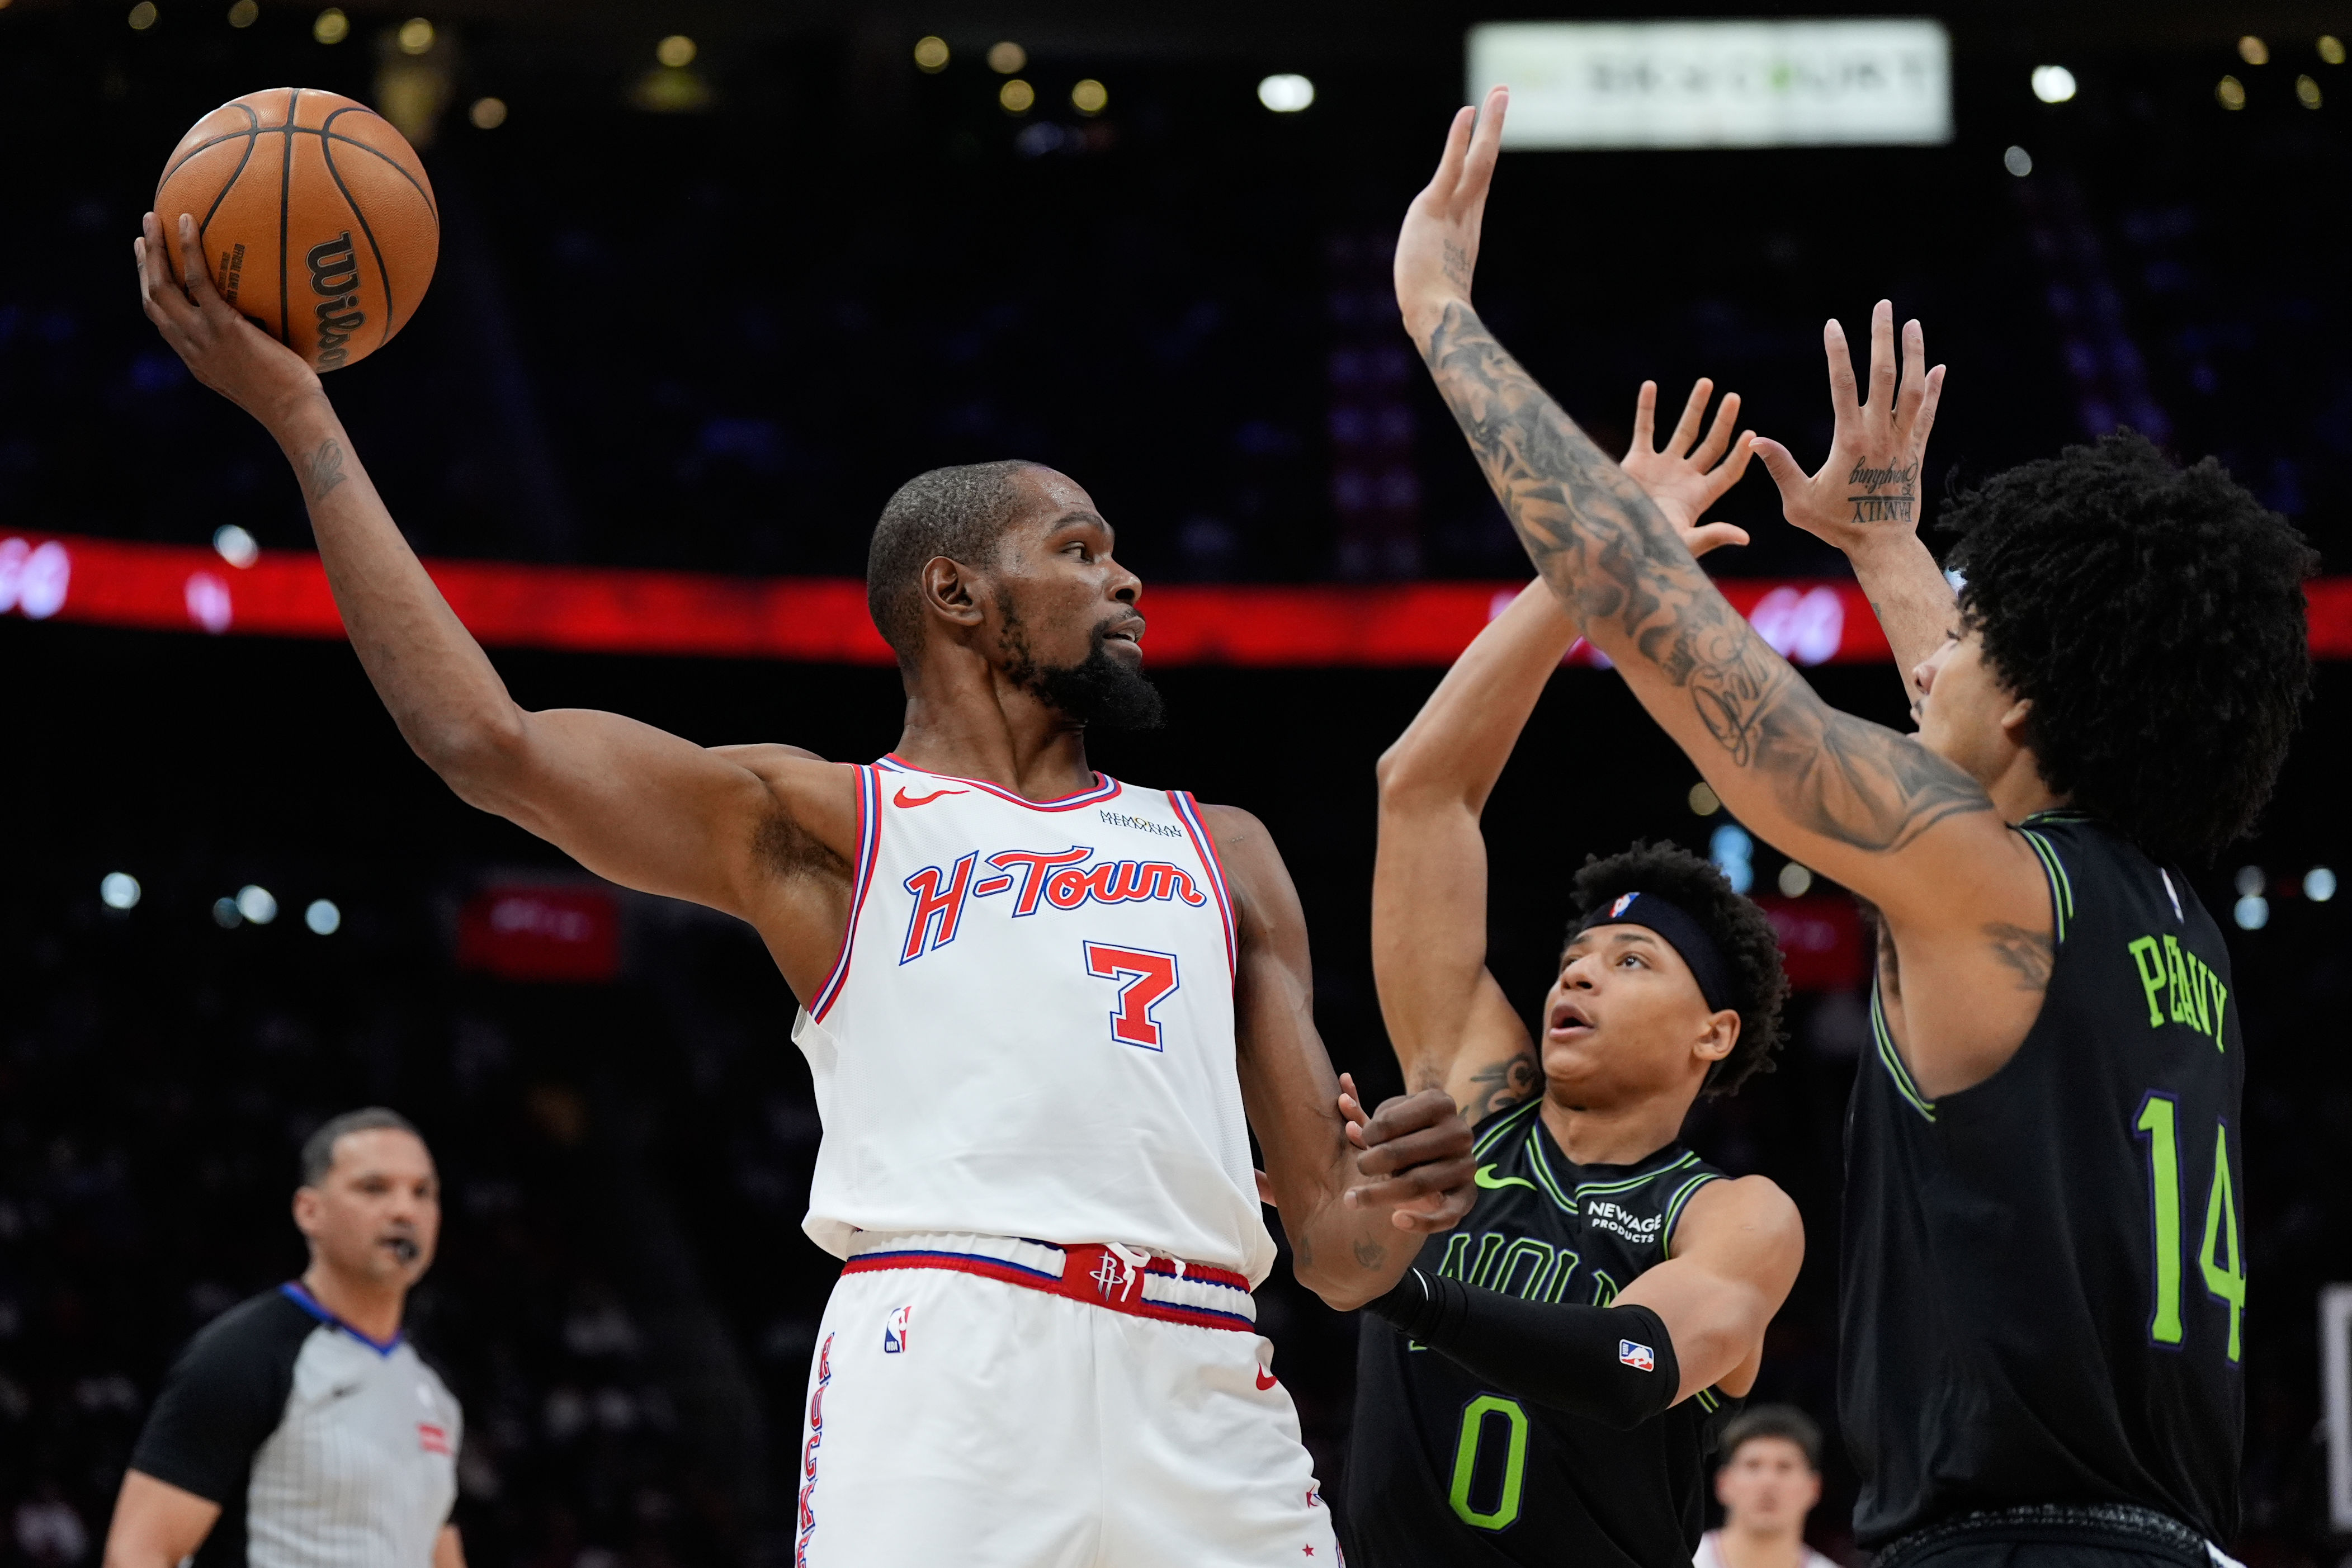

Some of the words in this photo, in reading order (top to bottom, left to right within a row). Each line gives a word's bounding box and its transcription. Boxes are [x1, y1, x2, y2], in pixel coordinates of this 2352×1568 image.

[1851, 501, 1912, 523] FAMILY
[1100, 810, 1181, 832] MEMORIAL
[1101, 815, 1182, 837] HERMANN
[899, 845, 1207, 966] H-Town
[1083, 939, 1179, 1052] 7
[2128, 933, 2227, 1054] PEAVY
[1588, 1201, 1662, 1232] NEWAGE
[1591, 1218, 1655, 1244] PRODUCTS
[2133, 1089, 2246, 1367] 14
[886, 1341, 899, 1351] NBA
[1448, 1391, 1530, 1534] 0
